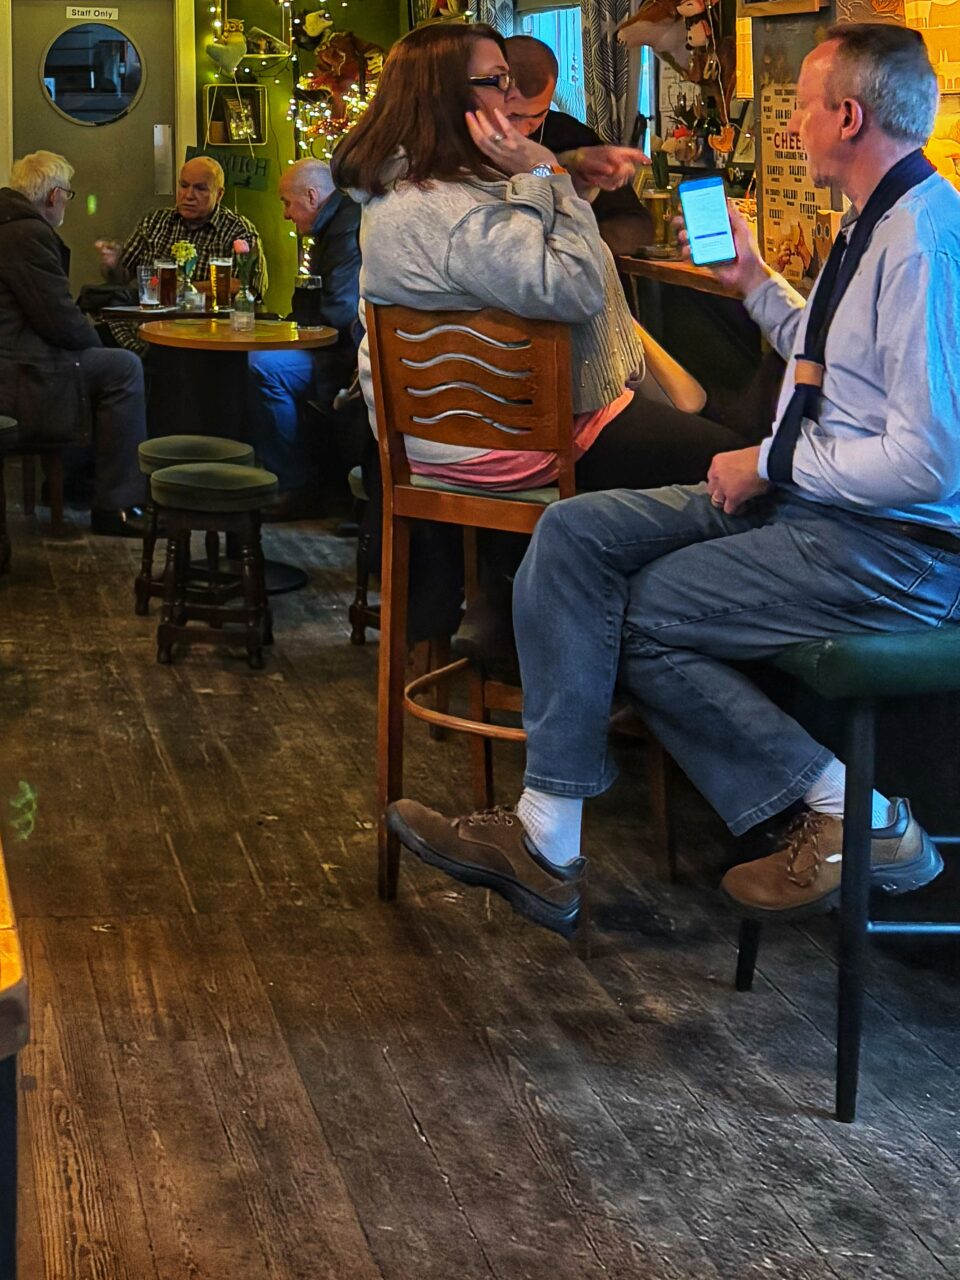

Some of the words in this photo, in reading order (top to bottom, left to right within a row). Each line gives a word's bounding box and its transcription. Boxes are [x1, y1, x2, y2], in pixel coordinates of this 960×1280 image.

[71, 8, 91, 17] Staff
[93, 9, 113, 19] Only
[774, 131, 806, 151] CHEE
